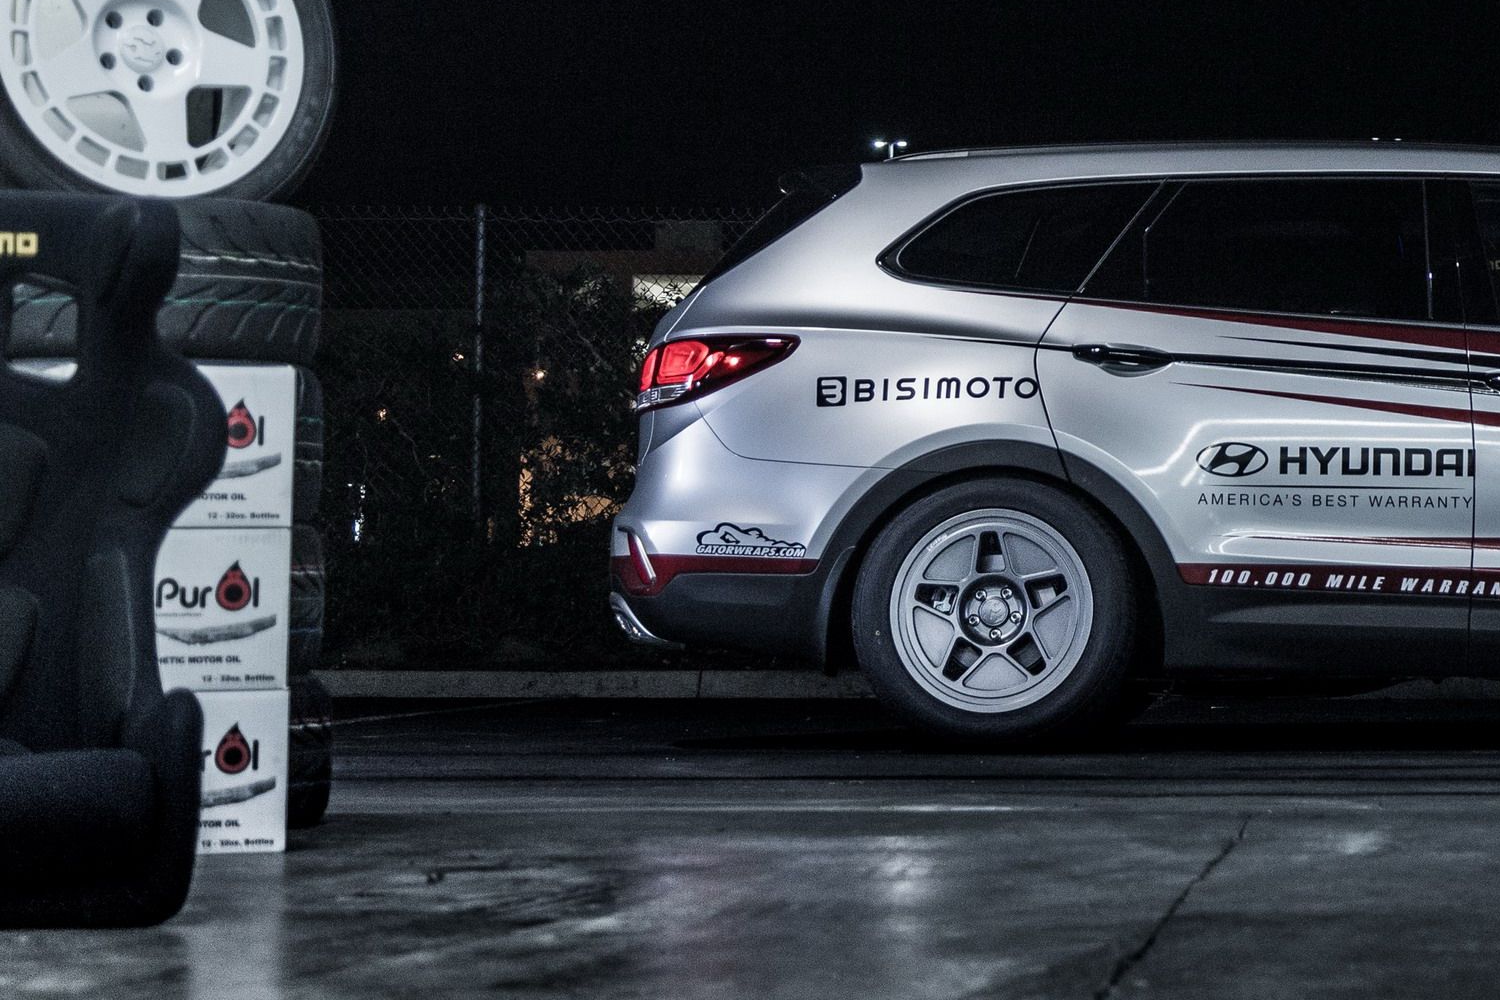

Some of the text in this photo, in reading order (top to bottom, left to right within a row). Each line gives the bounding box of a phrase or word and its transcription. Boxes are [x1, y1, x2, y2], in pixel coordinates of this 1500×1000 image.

[854, 376, 1039, 403] BISIMOTO
[1279, 446, 1475, 477] HYUNDAI
[1197, 492, 1473, 509] AMERICA'S BEST WARRANTY
[697, 544, 806, 557] GATORWRAPS.COM
[1325, 574, 1386, 591] MILE
[188, 655, 222, 664] MOTOR
